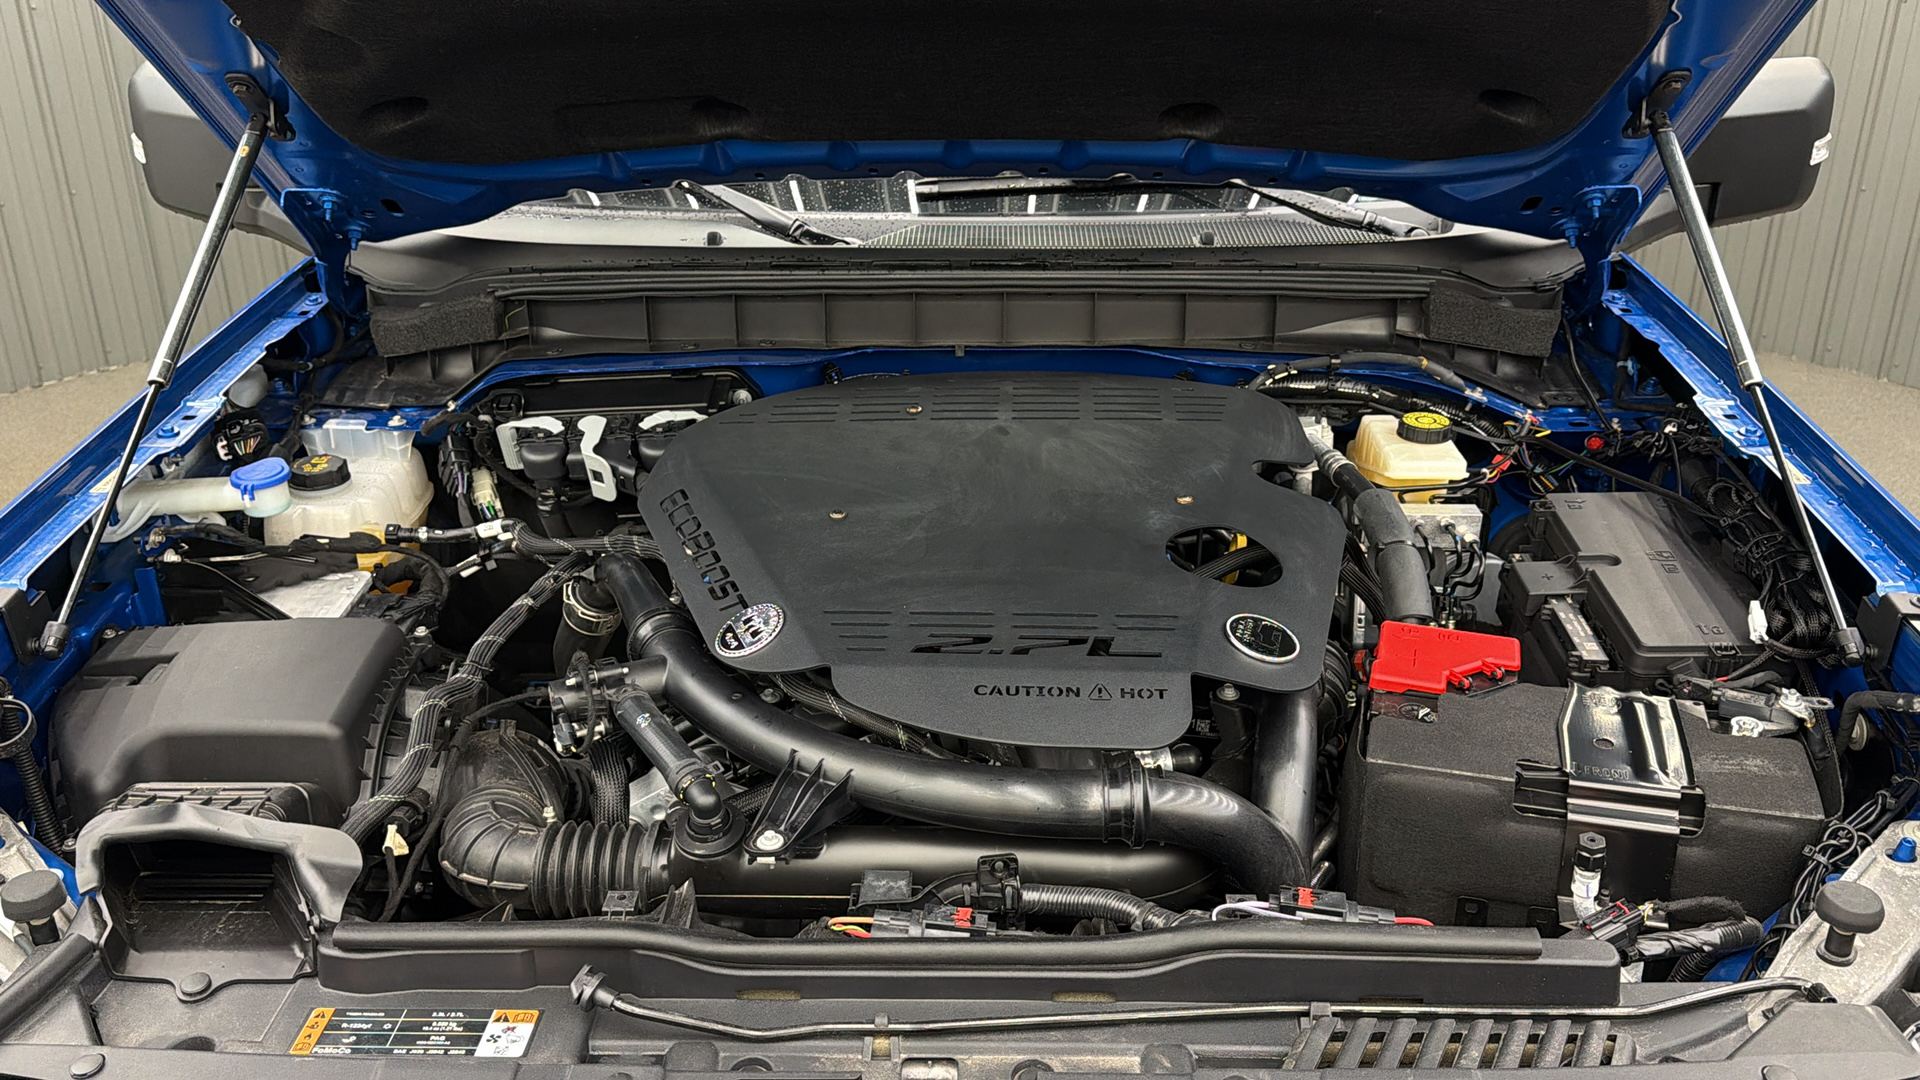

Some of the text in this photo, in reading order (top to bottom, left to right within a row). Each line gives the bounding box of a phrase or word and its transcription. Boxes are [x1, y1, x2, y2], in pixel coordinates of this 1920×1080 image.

[660, 488, 749, 612] ECOBOOST
[910, 633, 1163, 657] 2.7L
[973, 684, 1168, 700] CAUTION HOT
